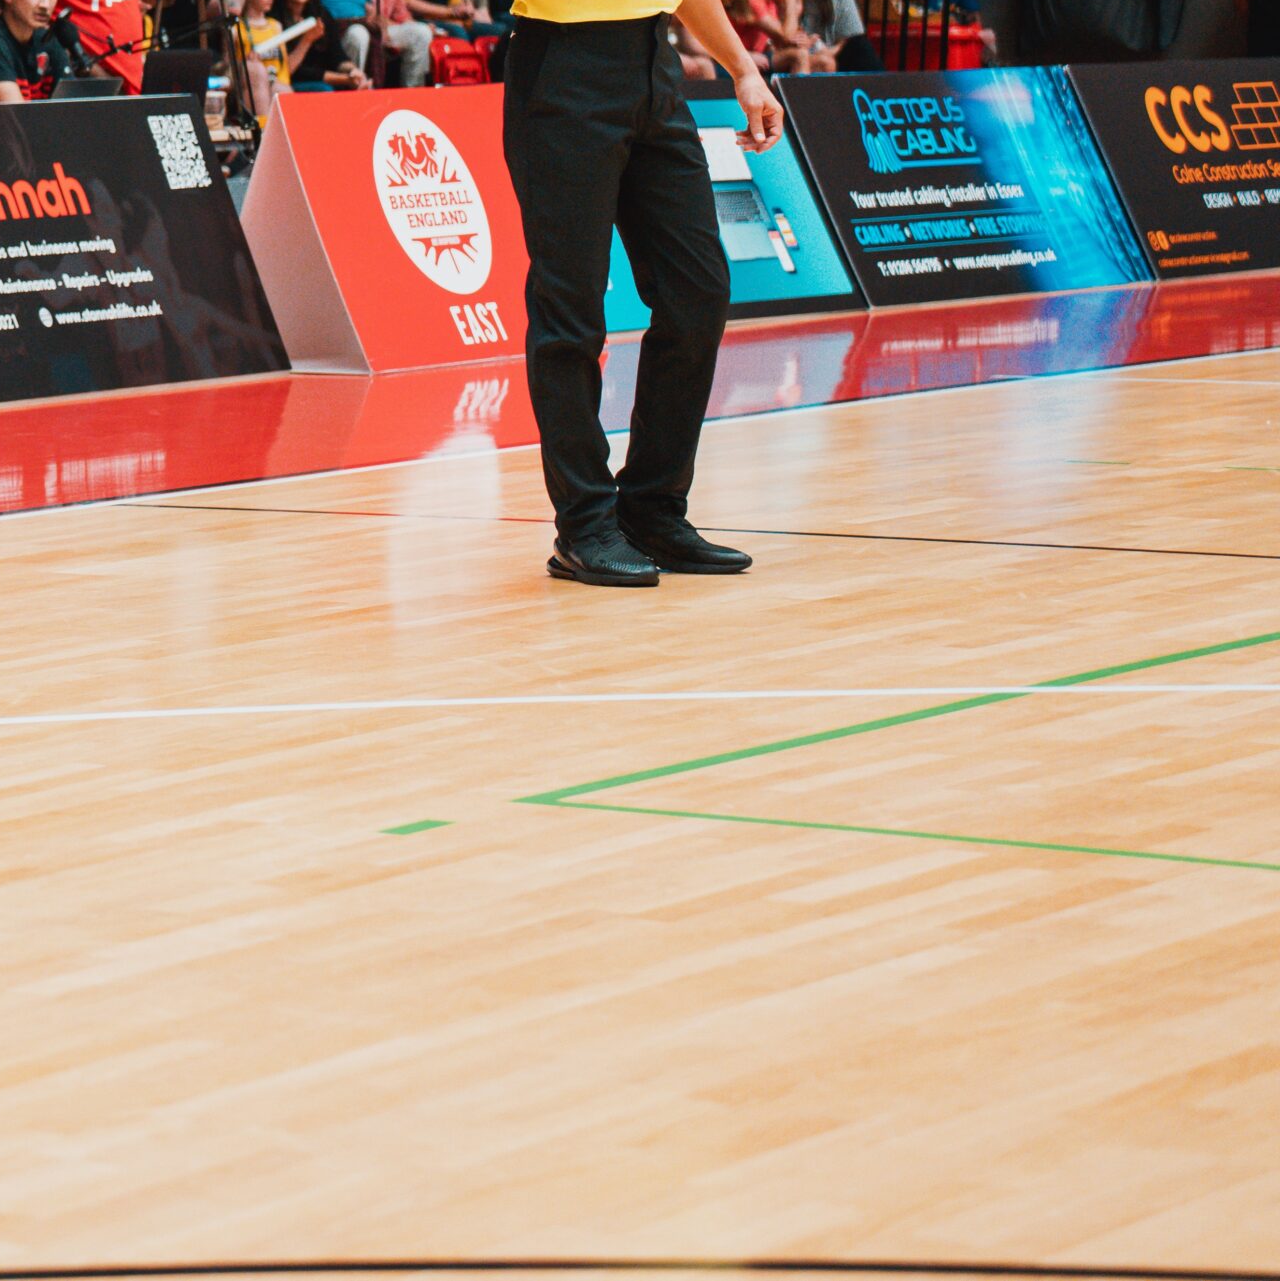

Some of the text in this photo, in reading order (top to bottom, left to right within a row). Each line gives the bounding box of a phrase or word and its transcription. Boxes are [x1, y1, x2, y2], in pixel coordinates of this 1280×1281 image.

[871, 96, 965, 126] OCTOPUS
[1144, 84, 1231, 154] CCS
[1172, 164, 1204, 184] Colne
[1202, 160, 1268, 182] Construction
[389, 189, 473, 210] BASKETBALL
[850, 181, 1025, 209] Your trusted cabling installer in Essex
[1202, 192, 1234, 209] DESIGN
[407, 210, 468, 229] ENGLAND
[854, 223, 907, 246] CABLING
[909, 219, 972, 241] NETWORKS
[974, 217, 1001, 236] FIRE
[6, 240, 28, 259] and
[27, 239, 80, 257] businesses
[79, 235, 117, 255] moving
[953, 247, 1057, 271] www.octopuscabling.co.uk
[62, 272, 101, 291] Repairs
[105, 266, 154, 287] Upgrades
[55, 300, 163, 325] www.stannahlifts.co.uk
[449, 302, 508, 346] EAST
